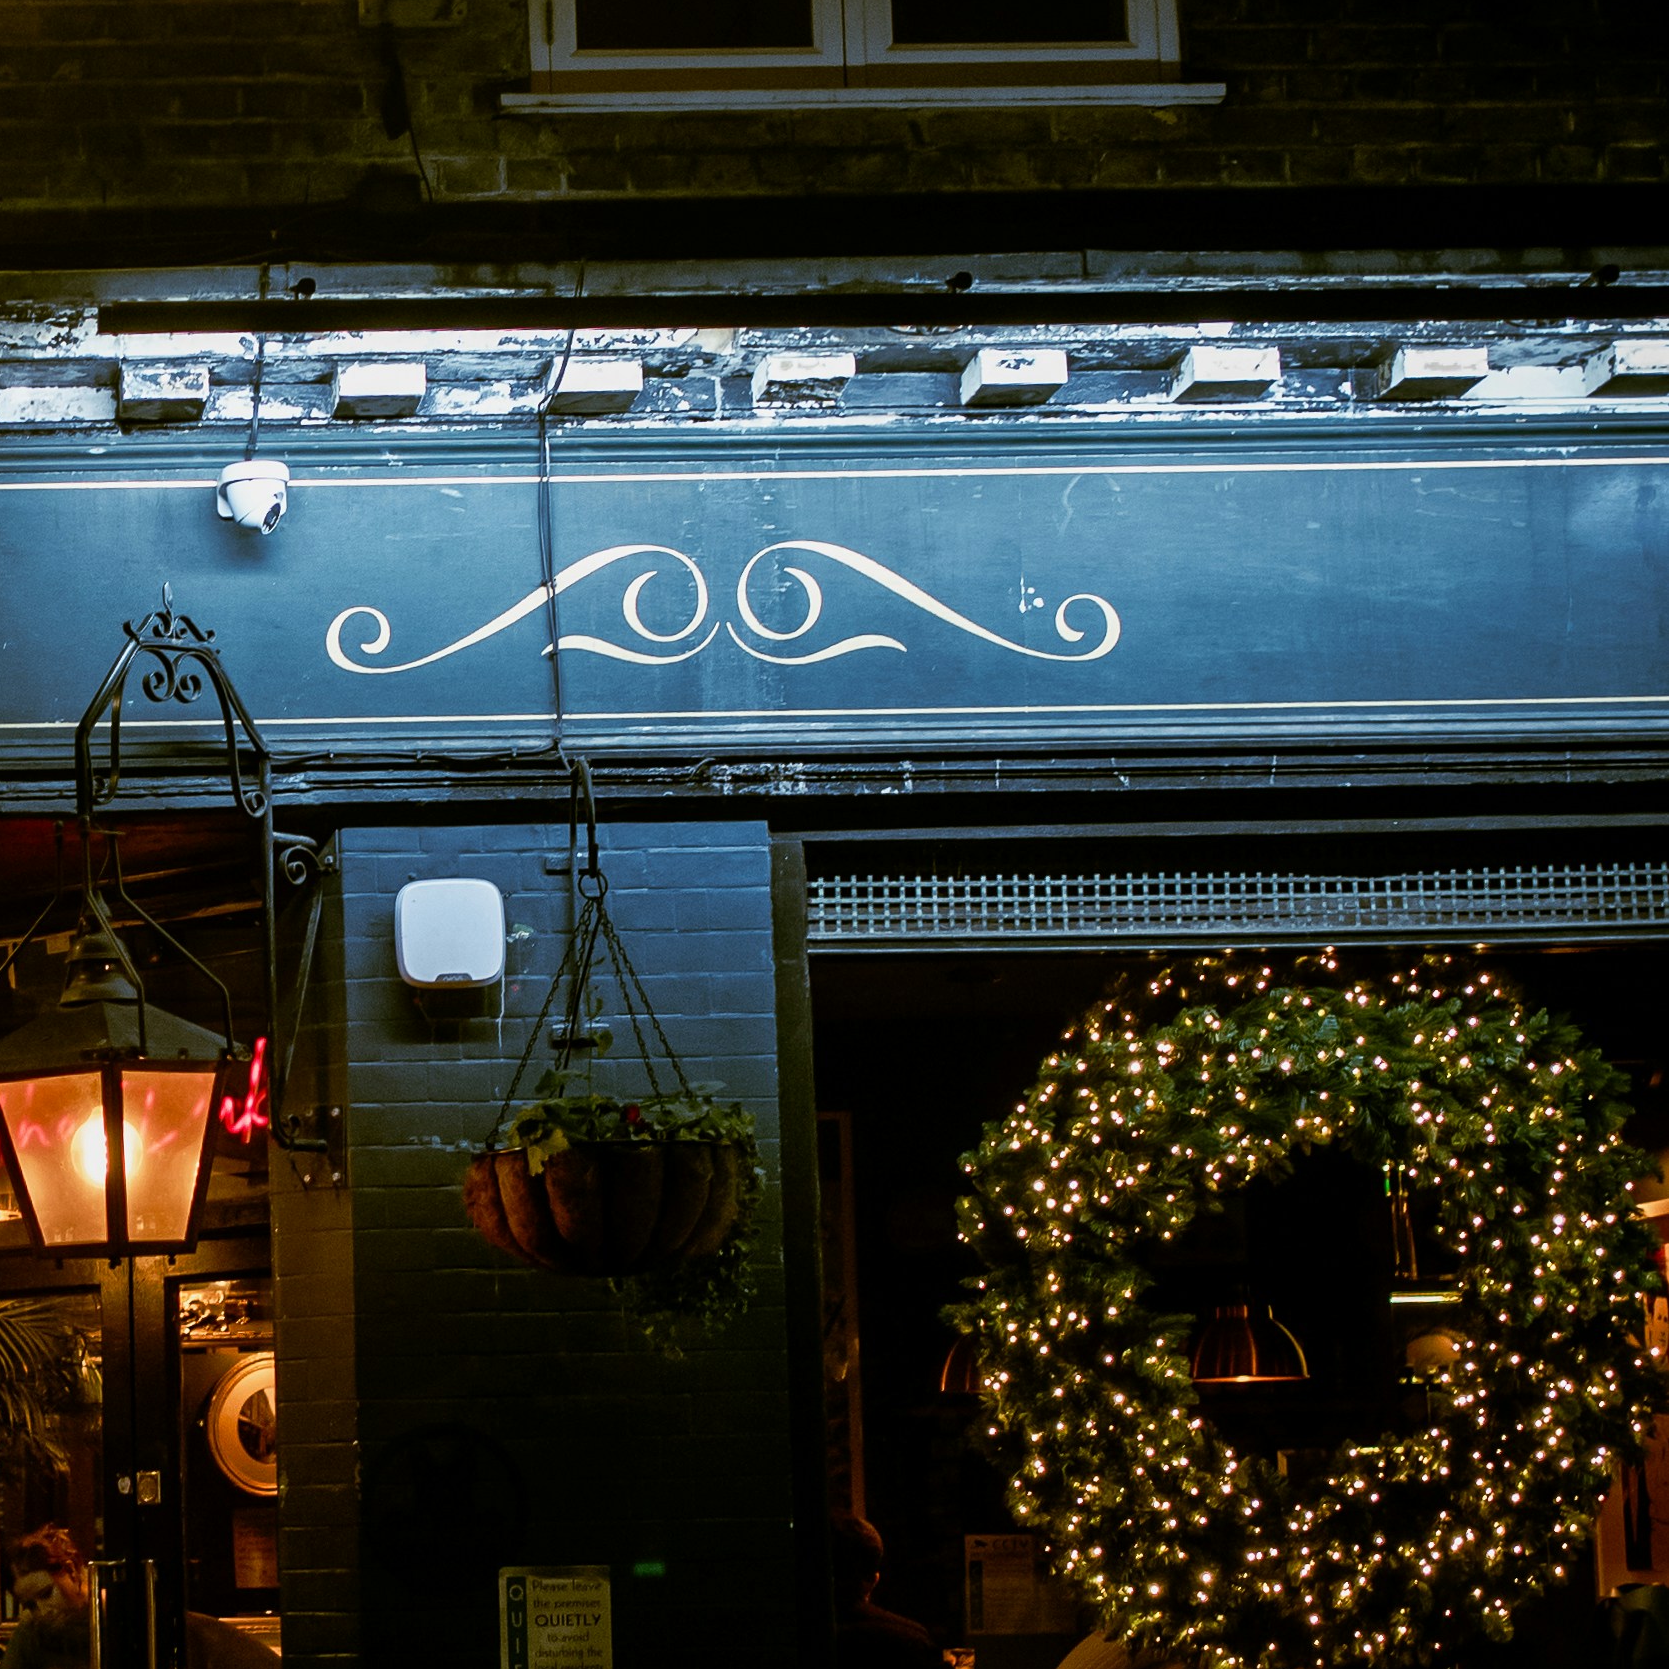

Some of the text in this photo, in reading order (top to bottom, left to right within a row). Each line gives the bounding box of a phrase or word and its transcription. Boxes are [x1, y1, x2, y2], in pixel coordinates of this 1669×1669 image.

[532, 1579, 602, 1591] Please leave
[533, 1597, 551, 1608] the
[534, 1613, 602, 1628] QUIETLY
[547, 1631, 590, 1643] to avoid
[535, 1646, 603, 1660] disturbing the
